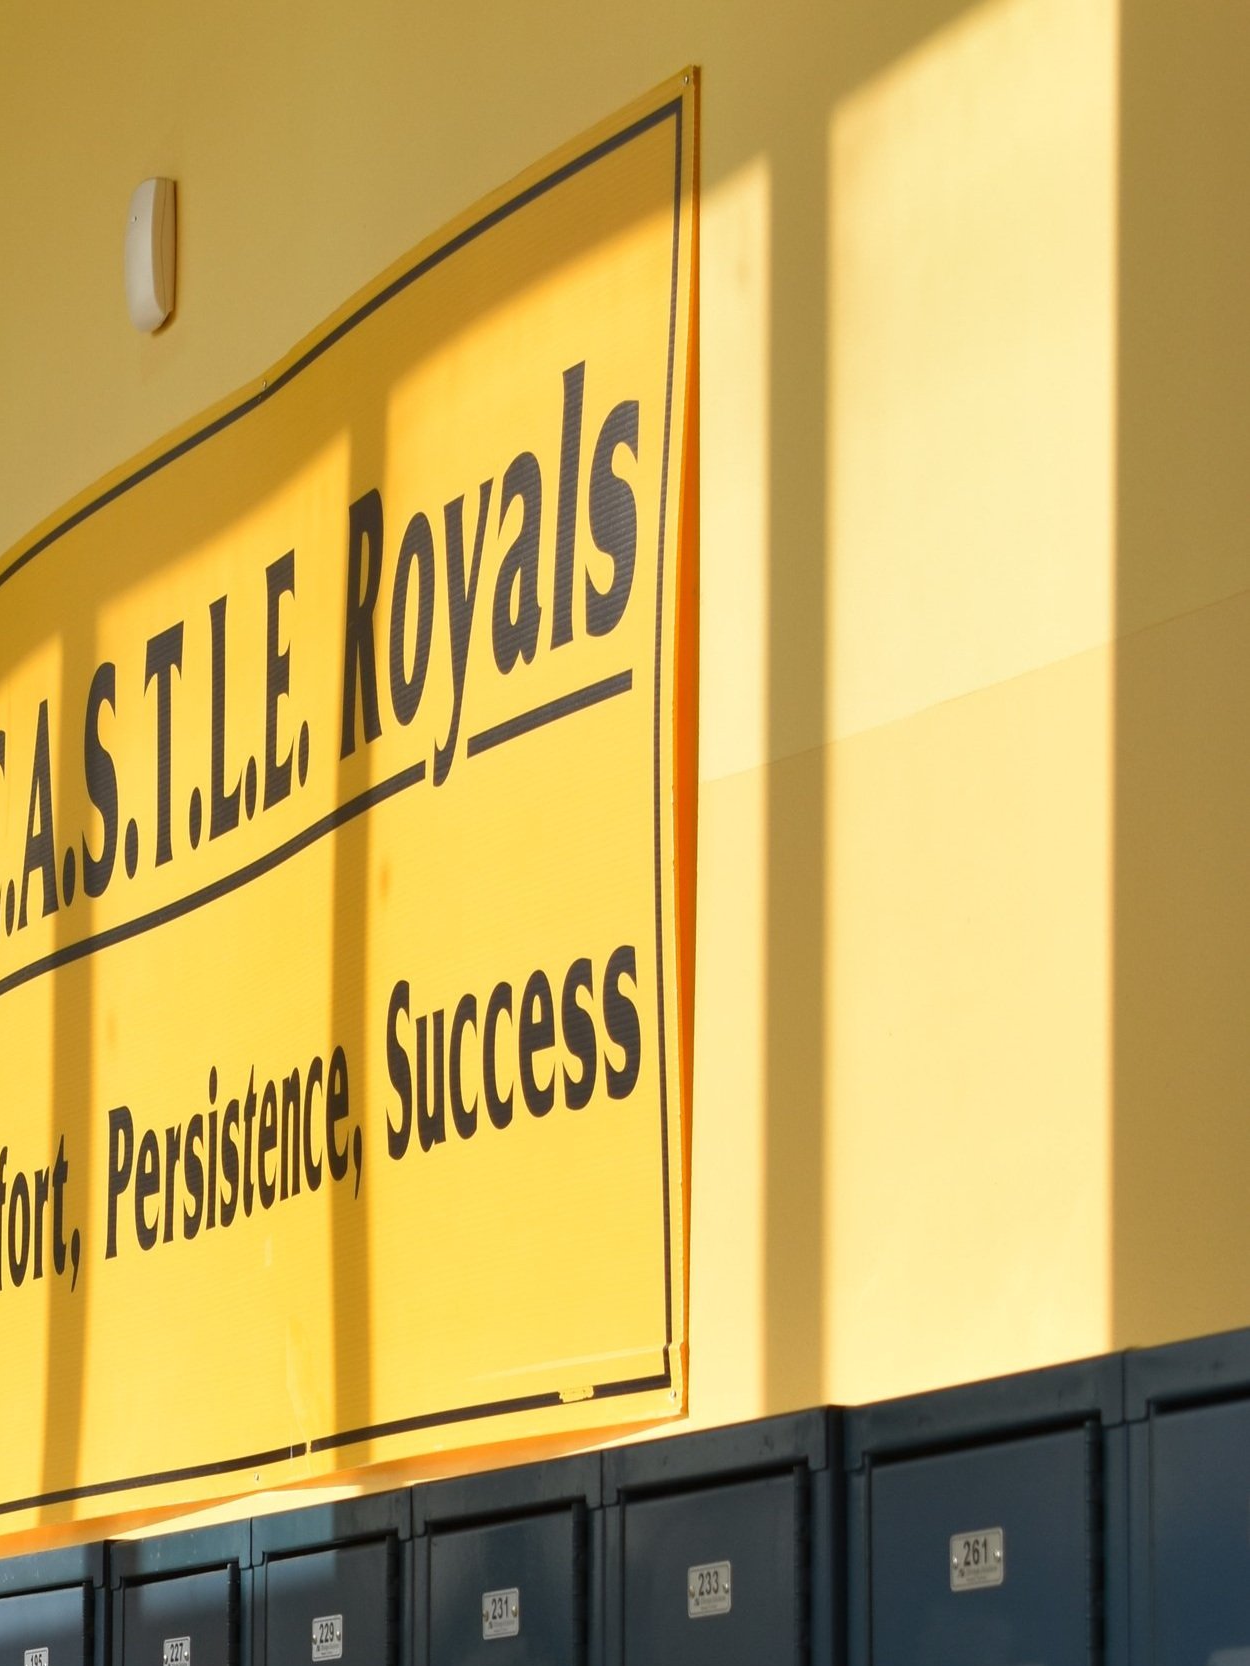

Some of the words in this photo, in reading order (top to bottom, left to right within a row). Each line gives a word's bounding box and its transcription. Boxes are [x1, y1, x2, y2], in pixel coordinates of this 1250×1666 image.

[339, 360, 639, 787] Royals
[105, 1045, 363, 1260] Persistence,
[385, 945, 642, 1161] Success
[963, 1538, 988, 1566] 261
[698, 1570, 719, 1597] 233
[491, 1597, 509, 1620] 231
[319, 1621, 334, 1643] 229
[170, 1642, 183, 1663] 227
